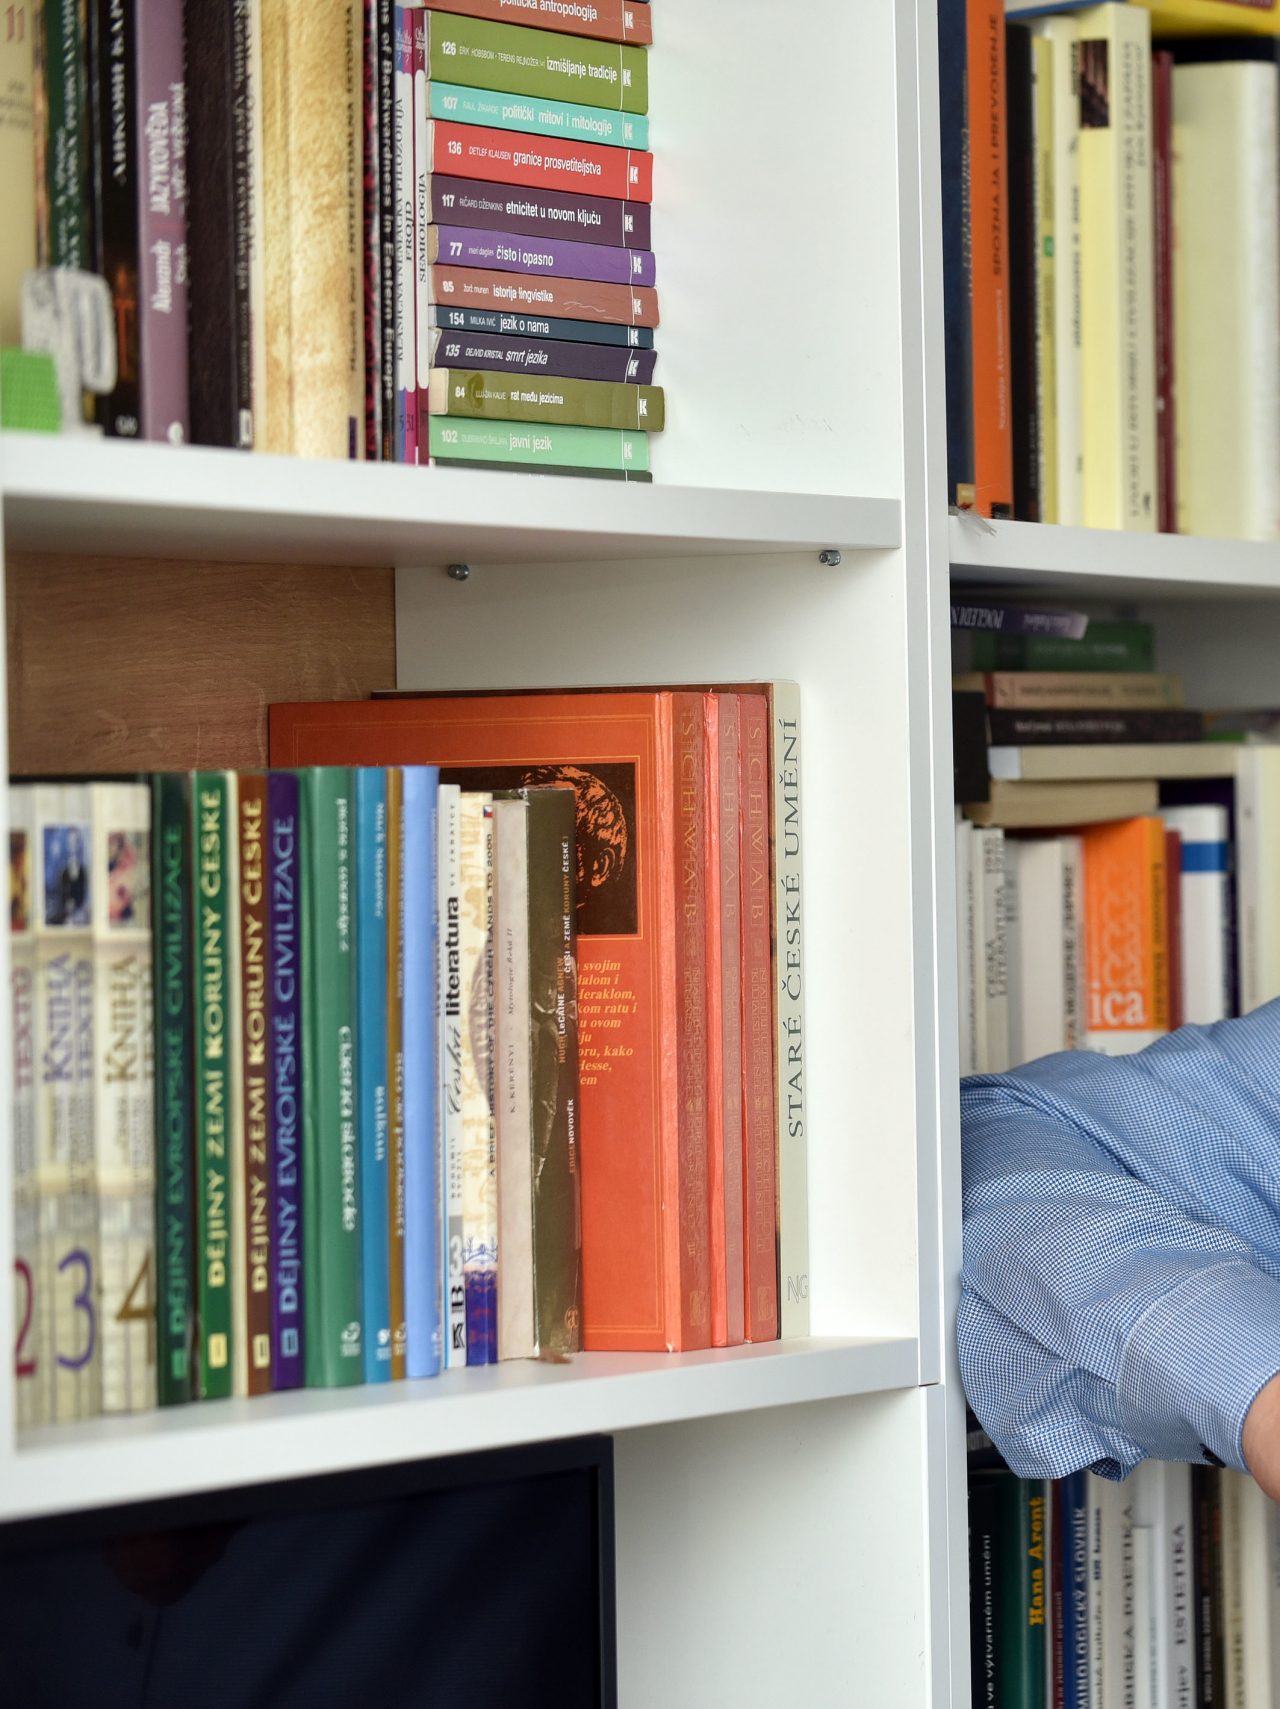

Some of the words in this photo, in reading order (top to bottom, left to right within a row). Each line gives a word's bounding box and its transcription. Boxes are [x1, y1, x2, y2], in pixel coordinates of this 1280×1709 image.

[540, 0, 598, 20] antropologija
[382, 32, 393, 55] of
[442, 41, 457, 56] 126
[459, 46, 470, 56] ERIK
[497, 52, 516, 64] TERENS
[546, 56, 587, 79] izmišljanje
[588, 64, 618, 82] tradicije
[381, 60, 394, 208] Backwardness
[443, 97, 458, 111] 107
[502, 104, 534, 121] politički
[538, 110, 564, 126] mitovi
[566, 112, 570, 126] i
[572, 116, 613, 137] mitologije
[447, 141, 462, 155] 136
[468, 146, 488, 156] DETLEF
[488, 149, 512, 161] KLAUSEN
[513, 151, 542, 166] granice
[544, 155, 602, 176] prosvetiteljstva
[383, 213, 394, 233] in
[405, 201, 414, 262] FROJD
[418, 172, 428, 283] SEMIOLOGIJA
[441, 194, 455, 208] 117
[459, 196, 478, 208] RIČARD
[506, 201, 538, 217] etnicitet
[540, 205, 546, 218] u
[548, 207, 575, 223] novom
[577, 206, 602, 227] ključu
[383, 242, 395, 320] Eastern
[450, 242, 463, 256] 77
[496, 245, 517, 262] čisto
[518, 248, 521, 262] i
[522, 252, 554, 268] opasno
[442, 281, 455, 293] 85
[493, 284, 517, 301] istorija
[518, 286, 554, 304] lingvistike
[449, 312, 465, 326] 154
[500, 314, 518, 332] jezik
[519, 320, 526, 331] o
[527, 320, 550, 334] nama
[382, 327, 395, 400] Europe
[445, 344, 461, 357] 135
[483, 349, 504, 360] KRISTAL
[505, 350, 526, 363] smrt
[525, 349, 549, 366] jezika
[455, 386, 466, 398] 84
[510, 390, 520, 401] rat
[520, 391, 538, 402] među
[538, 391, 564, 406] jezicima
[441, 430, 459, 444] 102
[509, 432, 531, 451] javni
[532, 434, 553, 453] jezik
[778, 718, 800, 859] UMĚNÍ
[198, 789, 222, 899] ČESKÉ
[241, 797, 263, 906] ČESKÉ
[682, 722, 699, 921] SCHWAB
[724, 724, 738, 920] SCHWAB
[749, 727, 766, 920] SCHWAB
[486, 872, 493, 889] TO
[561, 841, 570, 873] ČESKÉ
[163, 826, 184, 1016] CIVILIZACE
[272, 814, 296, 1003] CIVILIZACE
[563, 874, 571, 913] KORUNY
[445, 896, 460, 1017] literatura
[562, 914, 571, 942] ZEMĚ
[780, 873, 802, 1001] ČESKÉ
[201, 905, 223, 1060] KORUNY
[244, 914, 265, 1065] KORUNY
[486, 948, 494, 997] CZECH
[556, 956, 565, 992] AGNEW
[562, 951, 571, 974] ČEŠI
[583, 959, 621, 975] svojim
[614, 974, 619, 985] i
[42, 952, 71, 1084] KNIHA
[104, 954, 138, 1085] KNIHA
[486, 1001, 494, 1028] THE
[590, 1020, 621, 1028] ovom
[604, 1003, 629, 1014] ratu
[632, 1002, 637, 1014] i
[1090, 981, 1146, 1026] ica
[487, 1034, 494, 1053] OF
[604, 1045, 633, 1057] kako
[271, 1011, 298, 1187] EVROPSKÉ
[487, 1060, 495, 1117] HISTORY
[782, 1014, 803, 1138] STARÉ
[163, 1028, 185, 1205] EVROPSKÉ
[205, 1168, 228, 1289] DĚJINY
[249, 1175, 271, 1293] DĚJINY
[277, 1196, 301, 1314] DĚJINY
[115, 1246, 155, 1366] 4
[166, 1215, 188, 1337] DĚJINY
[787, 1274, 808, 1304] NG
[13, 1257, 38, 1379] 2
[56, 1247, 96, 1372] 3
[1027, 1497, 1045, 1561] Arent
[1070, 1508, 1088, 1583] SLOVNÍK
[981, 1535, 992, 1586] umění
[1121, 1506, 1134, 1617] POETIKA
[1172, 1525, 1187, 1646] ESTETIKA
[1028, 1568, 1045, 1627] Hana
[983, 1591, 996, 1679] výtvarném
[985, 1682, 995, 1702] ve
